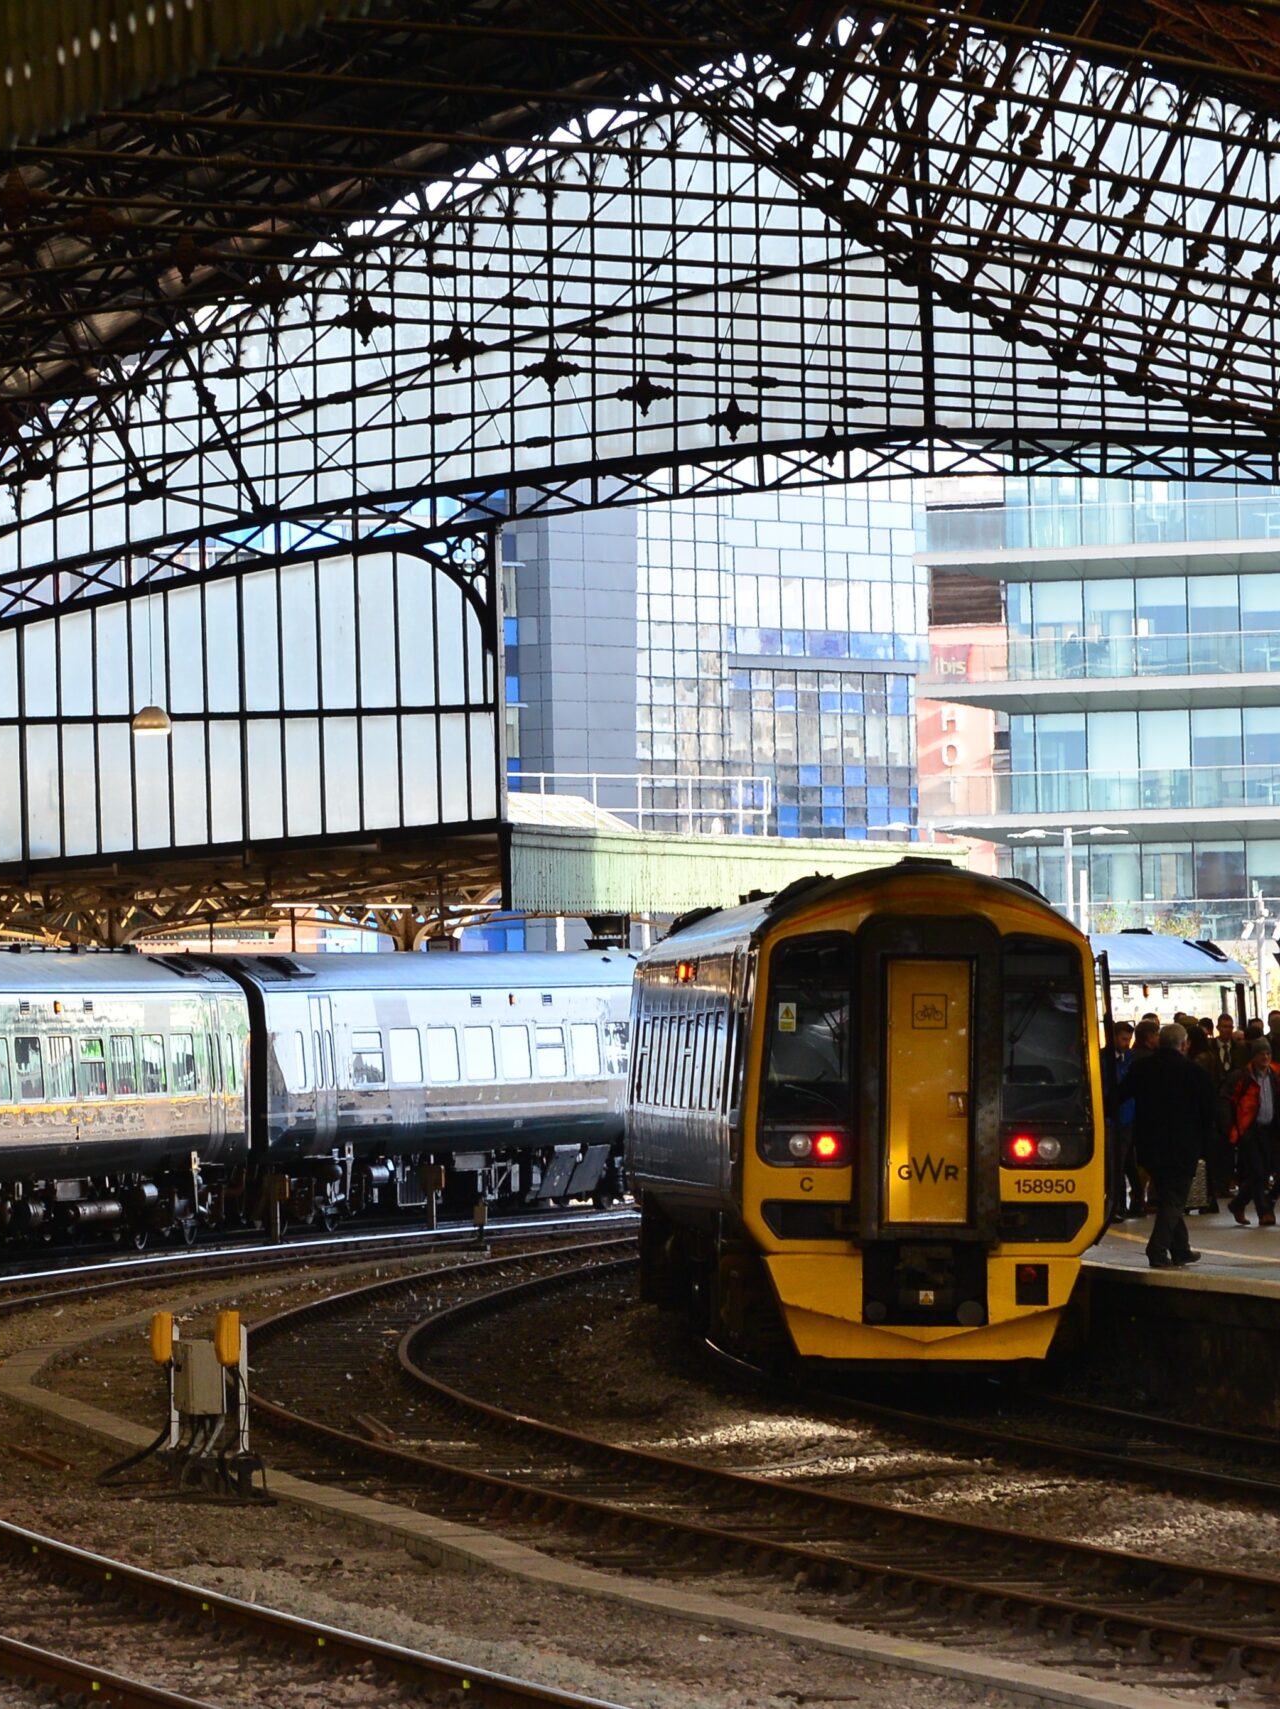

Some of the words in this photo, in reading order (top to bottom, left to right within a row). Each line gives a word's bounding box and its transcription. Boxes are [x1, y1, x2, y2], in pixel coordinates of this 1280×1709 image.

[935, 656, 967, 676] ibis
[940, 705, 964, 804] HOT
[897, 1154, 959, 1184] GWR
[799, 1177, 814, 1192] C
[1014, 1179, 1076, 1194] 158950
